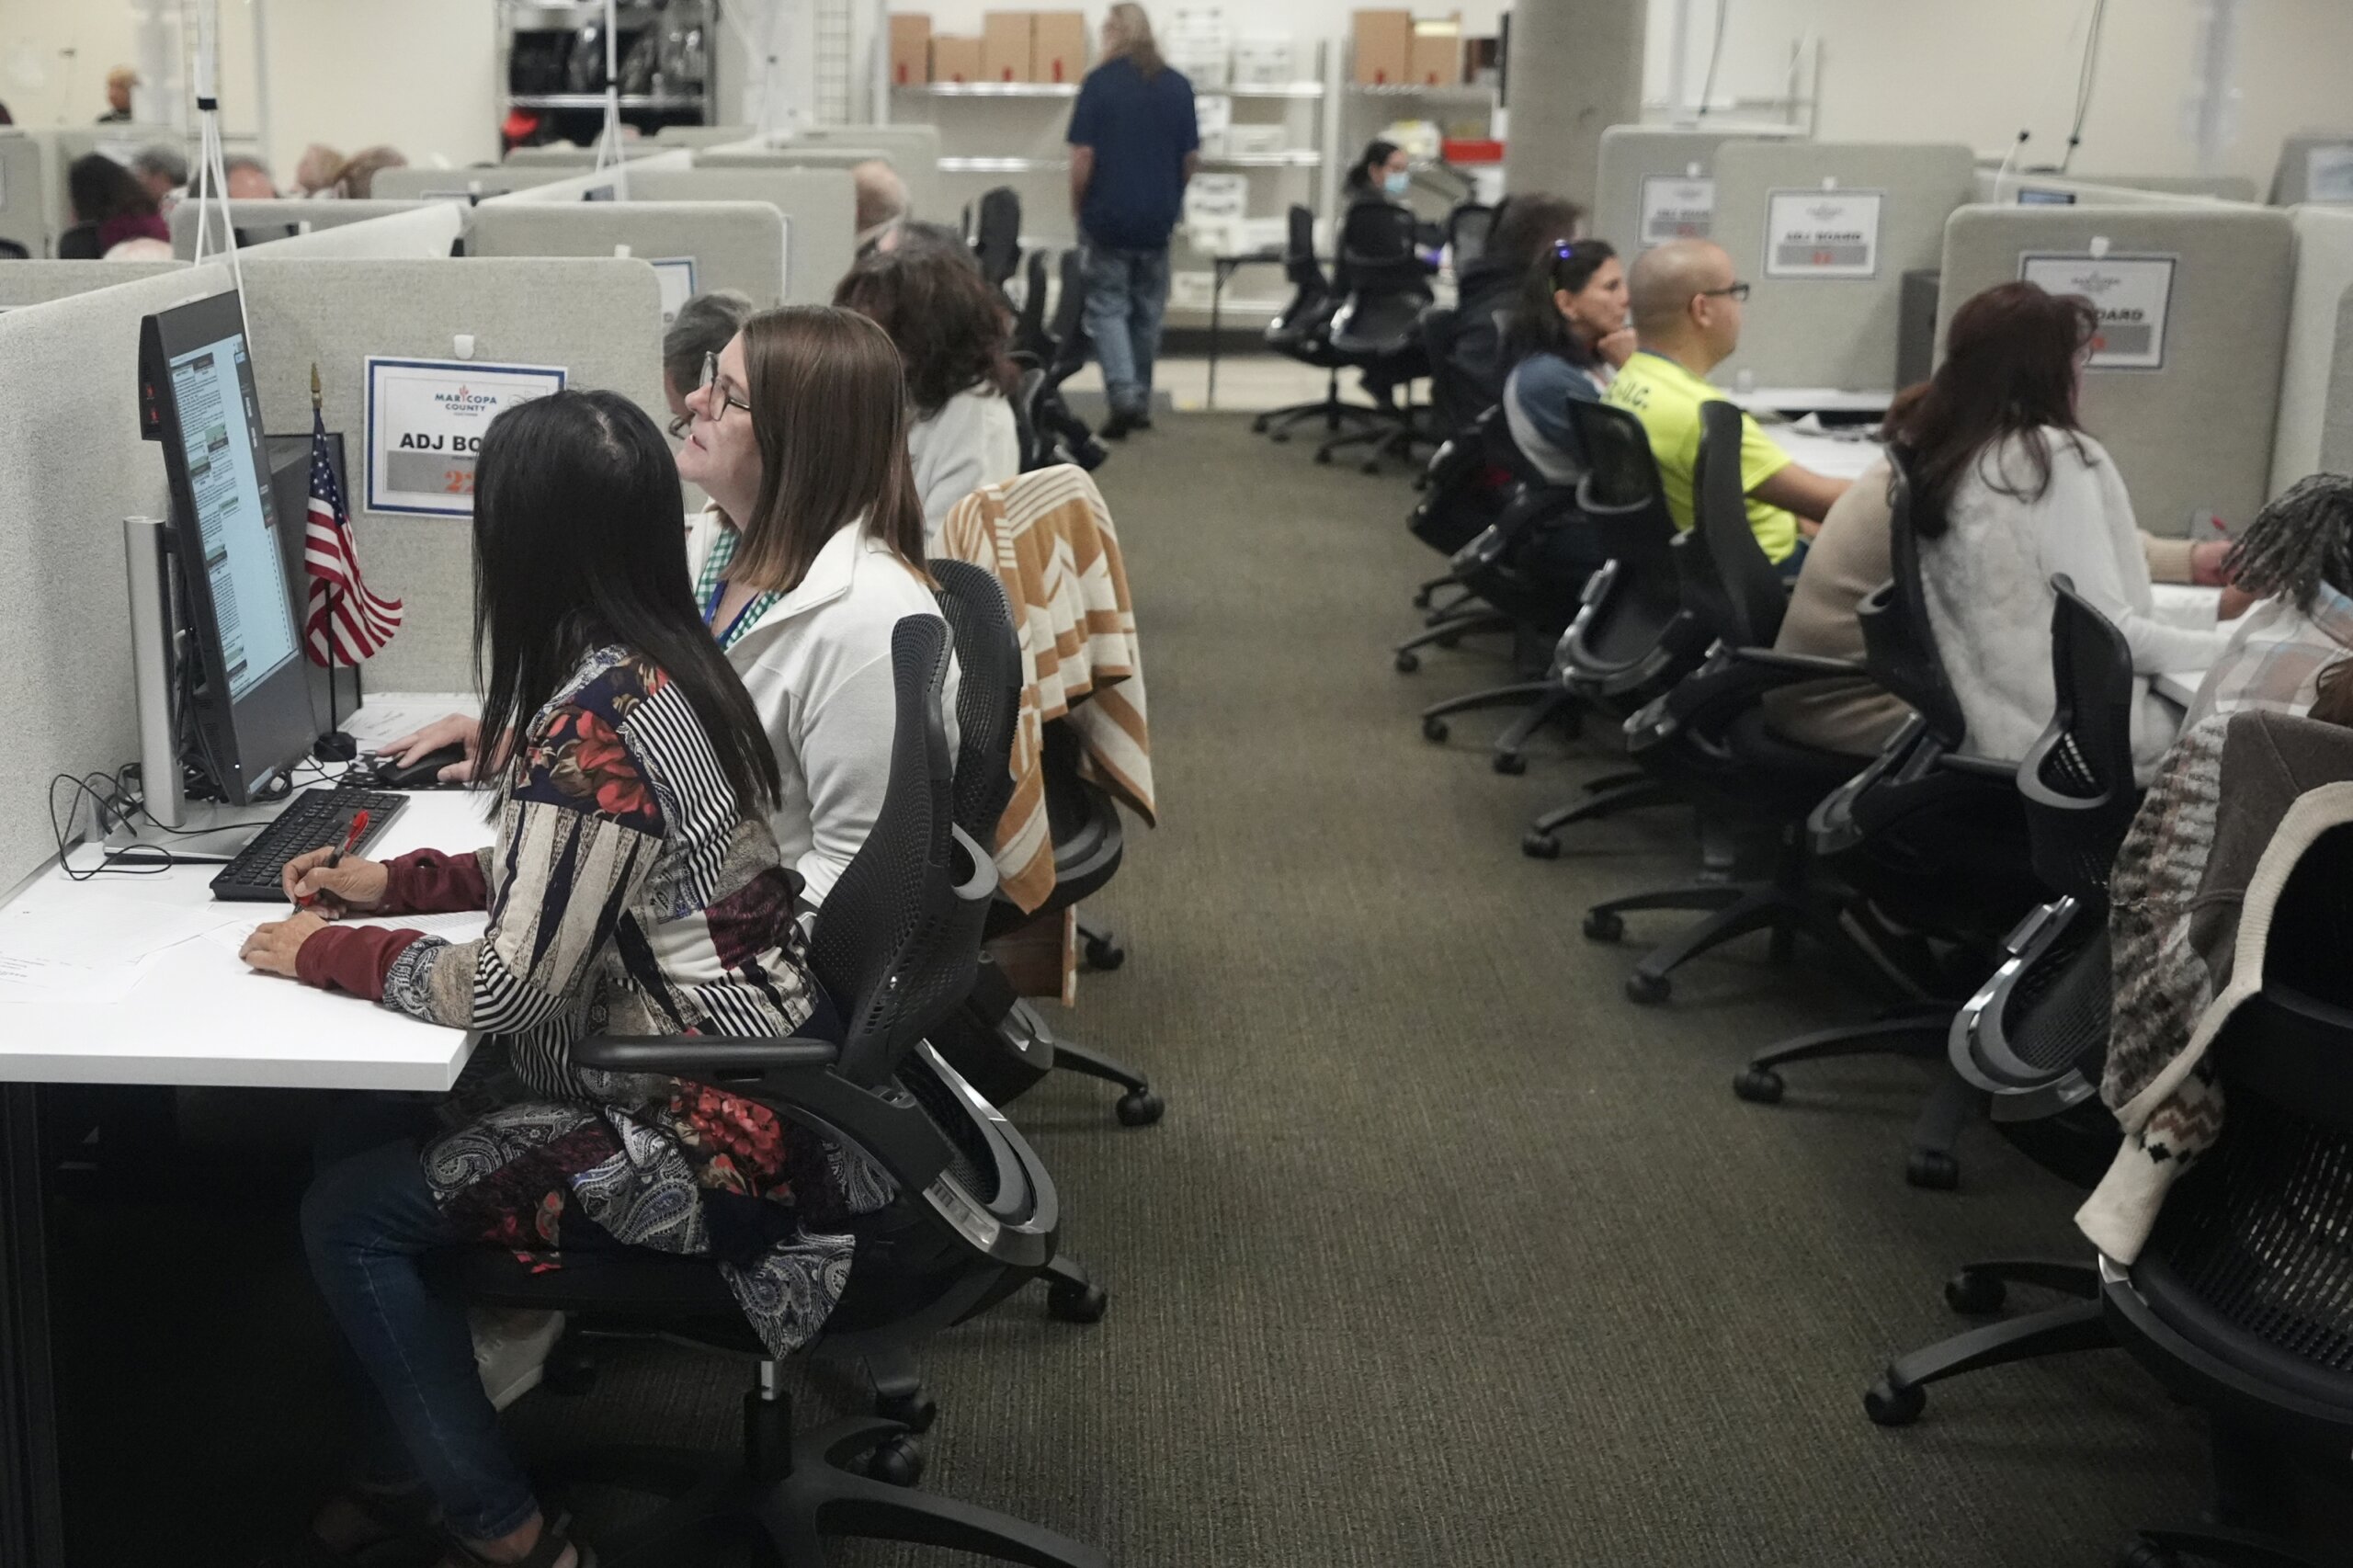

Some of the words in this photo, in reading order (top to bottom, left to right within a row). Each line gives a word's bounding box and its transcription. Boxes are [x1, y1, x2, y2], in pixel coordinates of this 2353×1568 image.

[2095, 308, 2143, 321] OARD
[435, 387, 496, 404] MARICOPA
[445, 403, 486, 412] COUNTY
[399, 433, 444, 449] ADJ
